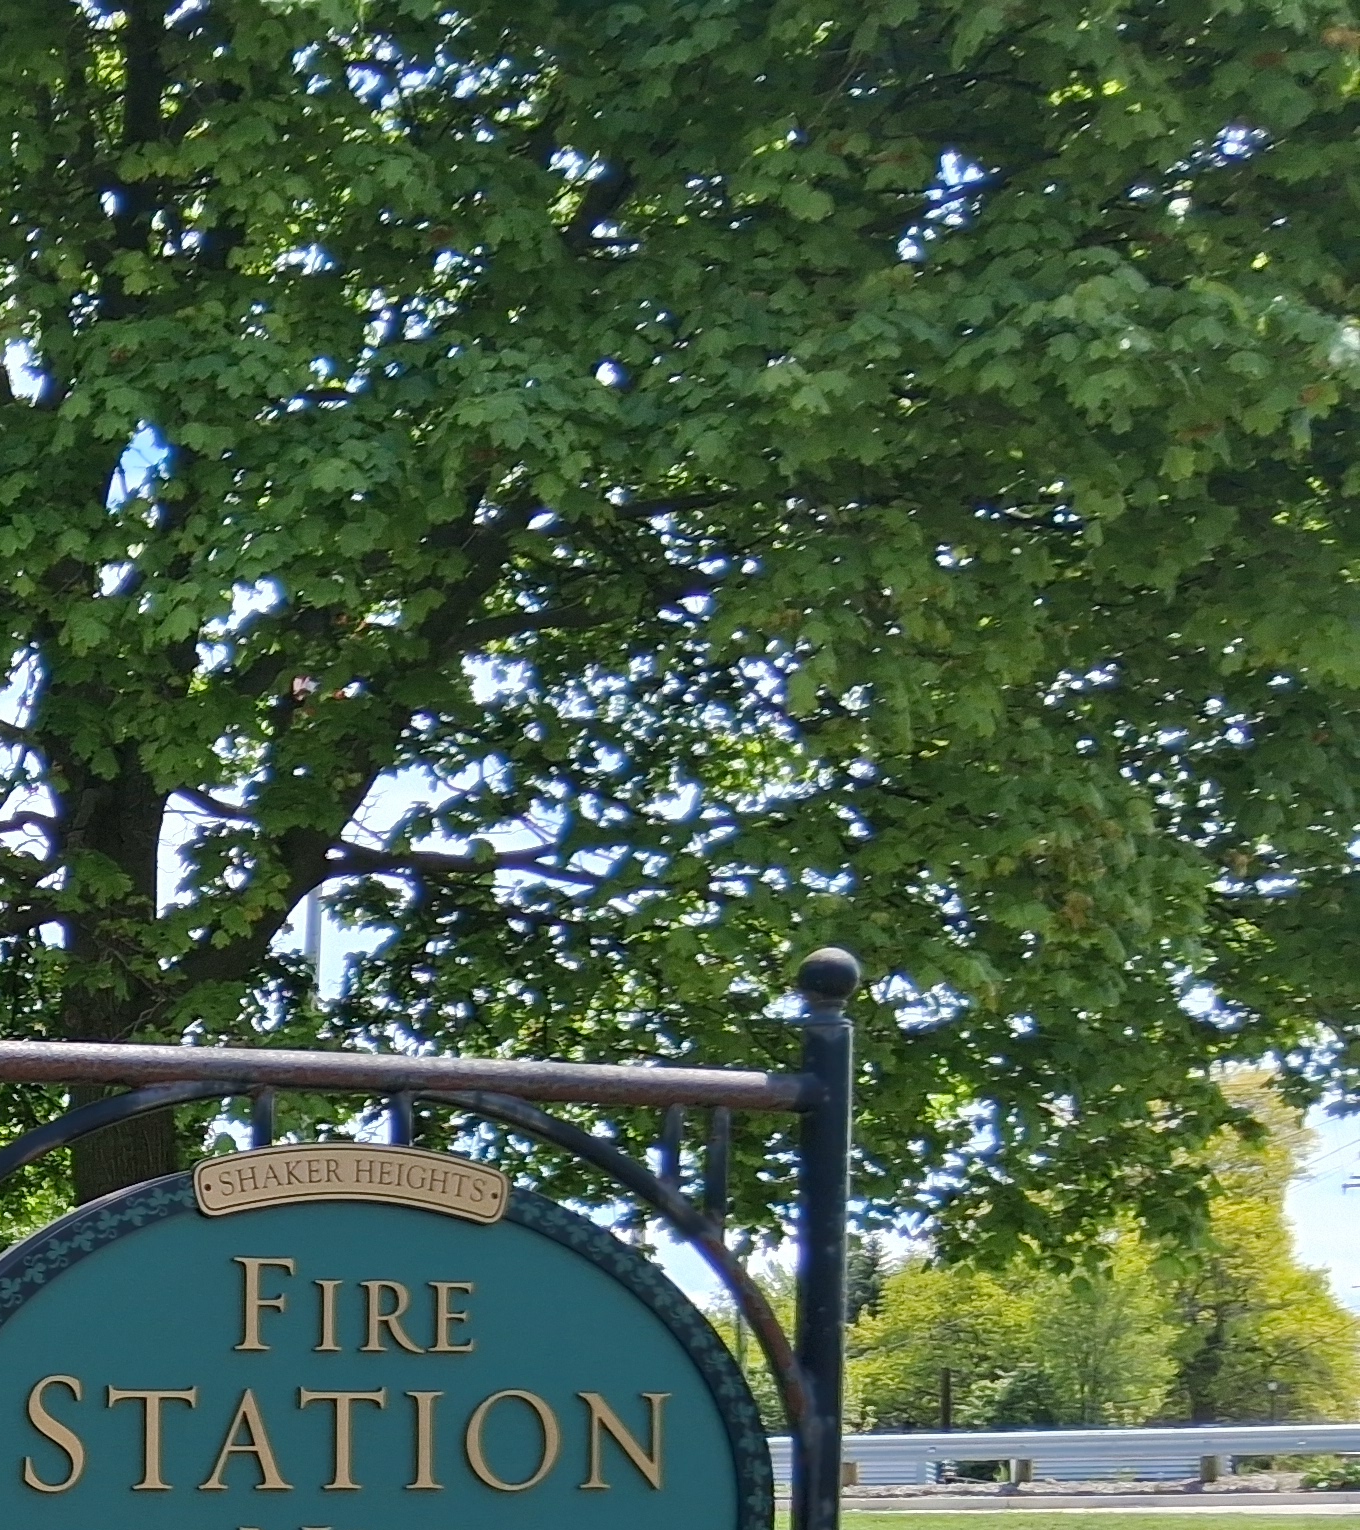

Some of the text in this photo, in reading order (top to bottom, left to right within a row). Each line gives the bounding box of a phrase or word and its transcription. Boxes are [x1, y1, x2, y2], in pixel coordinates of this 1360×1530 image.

[217, 1158, 488, 1203] SHAKER HEIGHTS
[233, 1256, 477, 1354] FIRE
[22, 1373, 672, 1494] STATION
